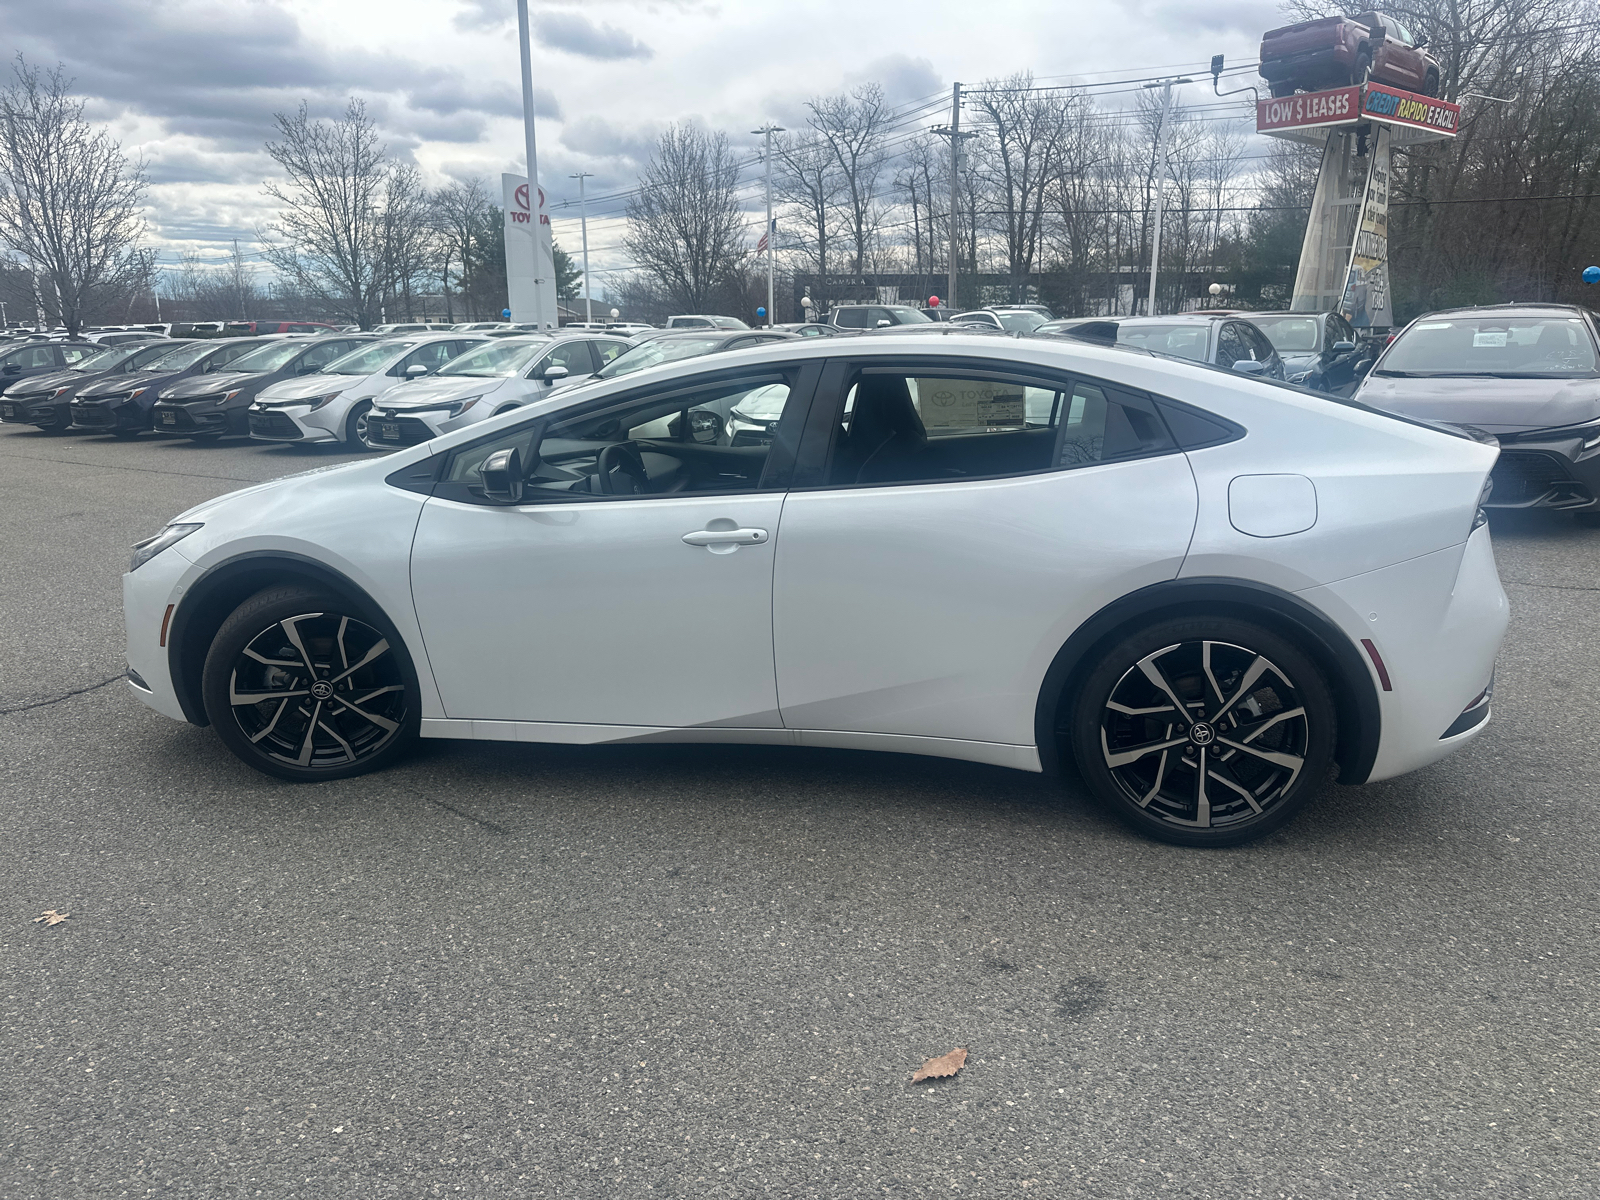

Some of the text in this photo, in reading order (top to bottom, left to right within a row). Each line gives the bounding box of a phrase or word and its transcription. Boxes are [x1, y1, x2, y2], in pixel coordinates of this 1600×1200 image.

[1265, 93, 1350, 124] LOW $ LEASES
[1365, 89, 1400, 116] CREDIT
[1397, 95, 1428, 122] RÁPIDO
[1426, 105, 1435, 124] E
[510, 211, 550, 225] TOYTA
